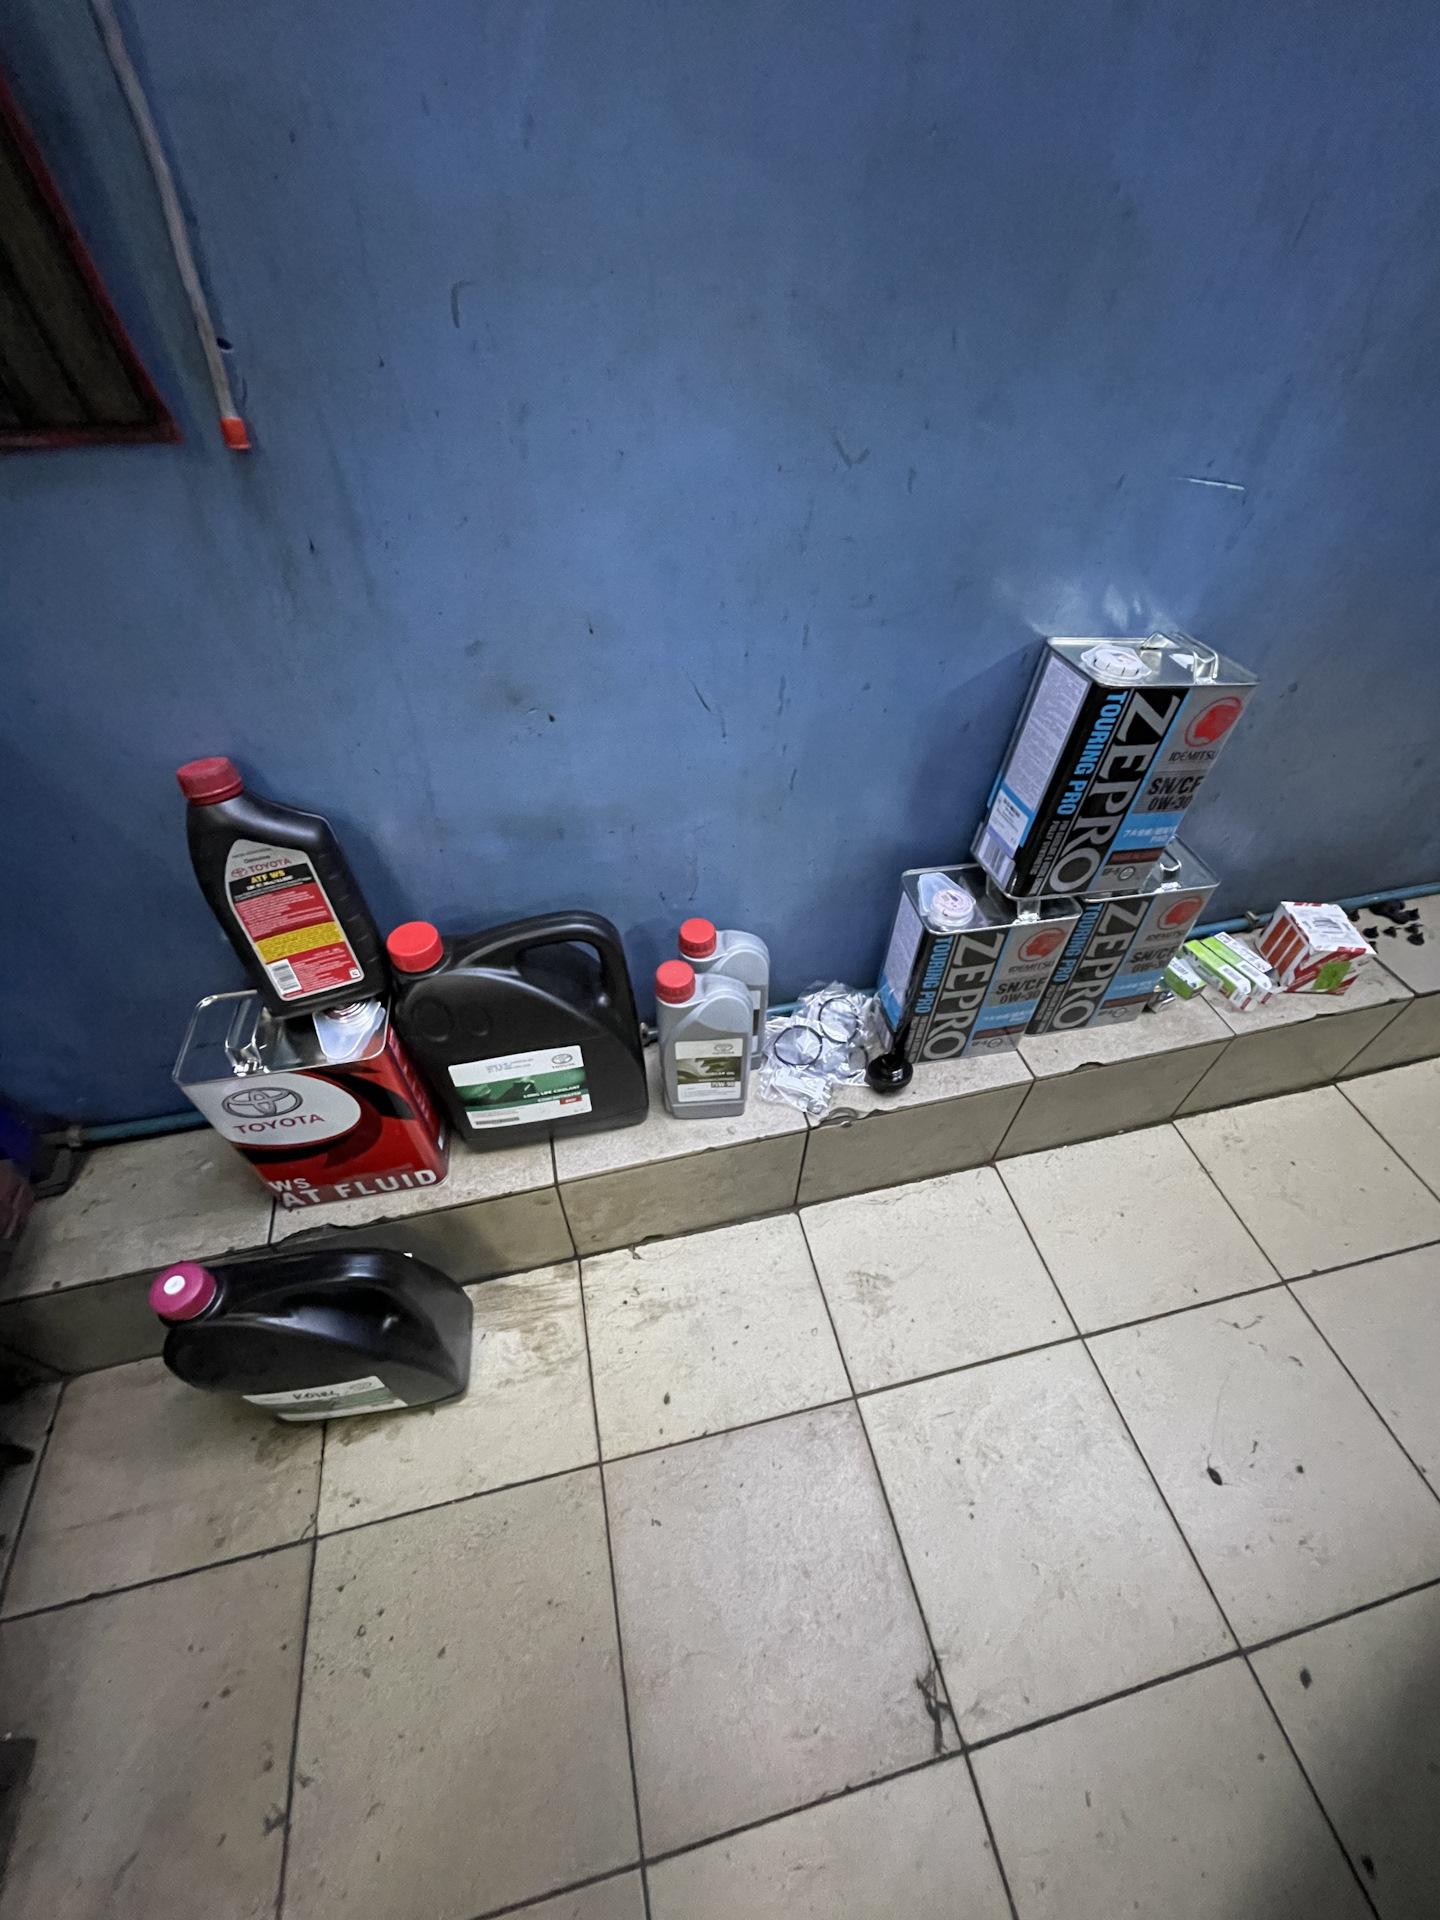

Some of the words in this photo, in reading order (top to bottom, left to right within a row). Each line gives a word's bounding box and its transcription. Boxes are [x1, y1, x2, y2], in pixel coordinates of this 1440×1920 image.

[1073, 691, 1129, 775] TOURING
[1049, 691, 1181, 893] ZEPRO
[1148, 776, 1206, 795] SN/CF
[1057, 779, 1088, 816] PRO
[1147, 795, 1193, 811] 0W-30
[248, 858, 292, 873] TOYOTA
[250, 873, 268, 884] ATF
[269, 870, 286, 879] WS
[1064, 903, 1104, 957] TOURING
[921, 936, 954, 989] TOURING
[1008, 960, 1055, 973] IDEMITSU
[1051, 959, 1078, 983] PRO
[1052, 900, 1149, 1029] ZEPRO
[922, 933, 1005, 1060] ZEPRO
[996, 977, 1047, 995] SN/CF
[1000, 990, 1041, 1005] 0W-30
[914, 991, 937, 1014] PRO
[233, 1113, 325, 1135] TOYOTA
[268, 1177, 312, 1193] WS
[283, 1188, 322, 1208] AT
[333, 1169, 438, 1199] FLUID
